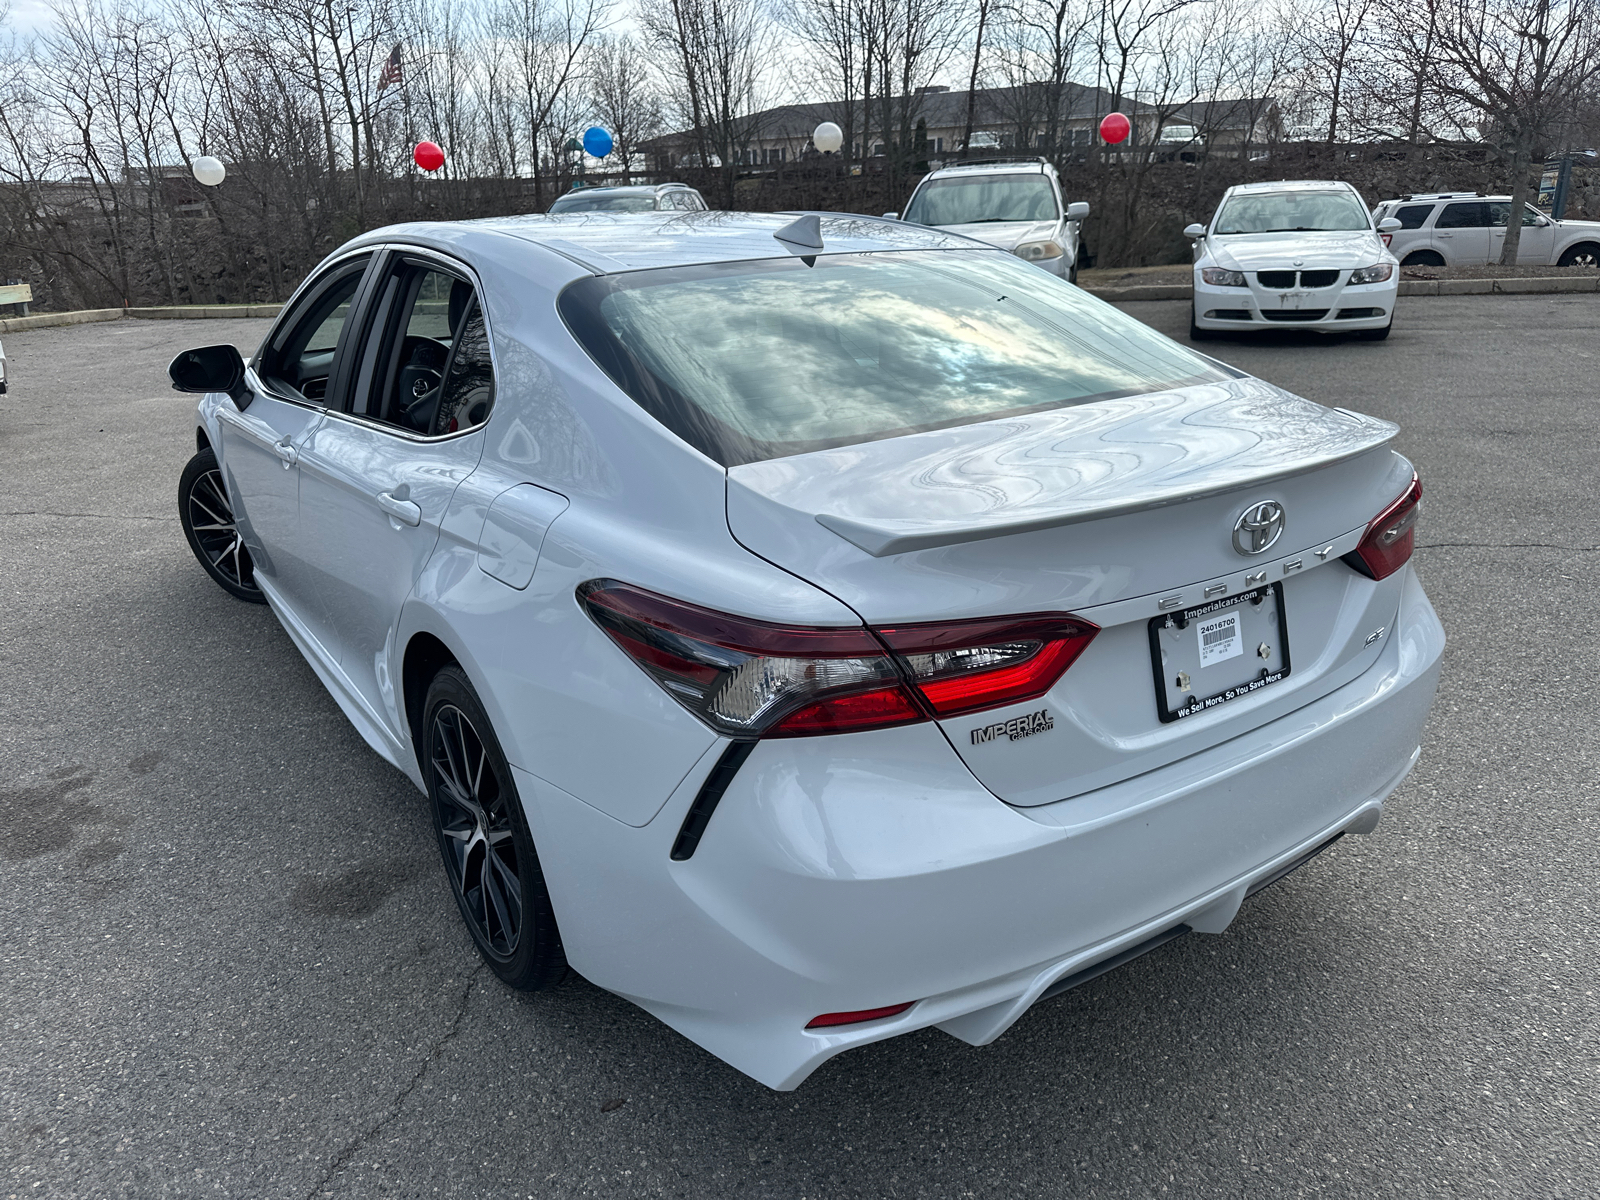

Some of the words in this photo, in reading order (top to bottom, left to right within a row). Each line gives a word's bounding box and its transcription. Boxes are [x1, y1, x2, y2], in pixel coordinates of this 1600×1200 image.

[1158, 545, 1333, 610] CAMRY
[1183, 590, 1258, 620] Imperialcars.com
[1200, 617, 1236, 634] 24016700
[1363, 626, 1385, 649] SE
[1177, 708, 1190, 718] We
[1190, 701, 1205, 714] Sell
[1205, 695, 1225, 708] More,
[1225, 690, 1235, 700] So
[1235, 686, 1249, 697] You
[1249, 679, 1265, 691] Save
[1265, 672, 1282, 685] More
[971, 709, 1054, 745] IMPERIAL
[1010, 724, 1054, 741] cars.com
